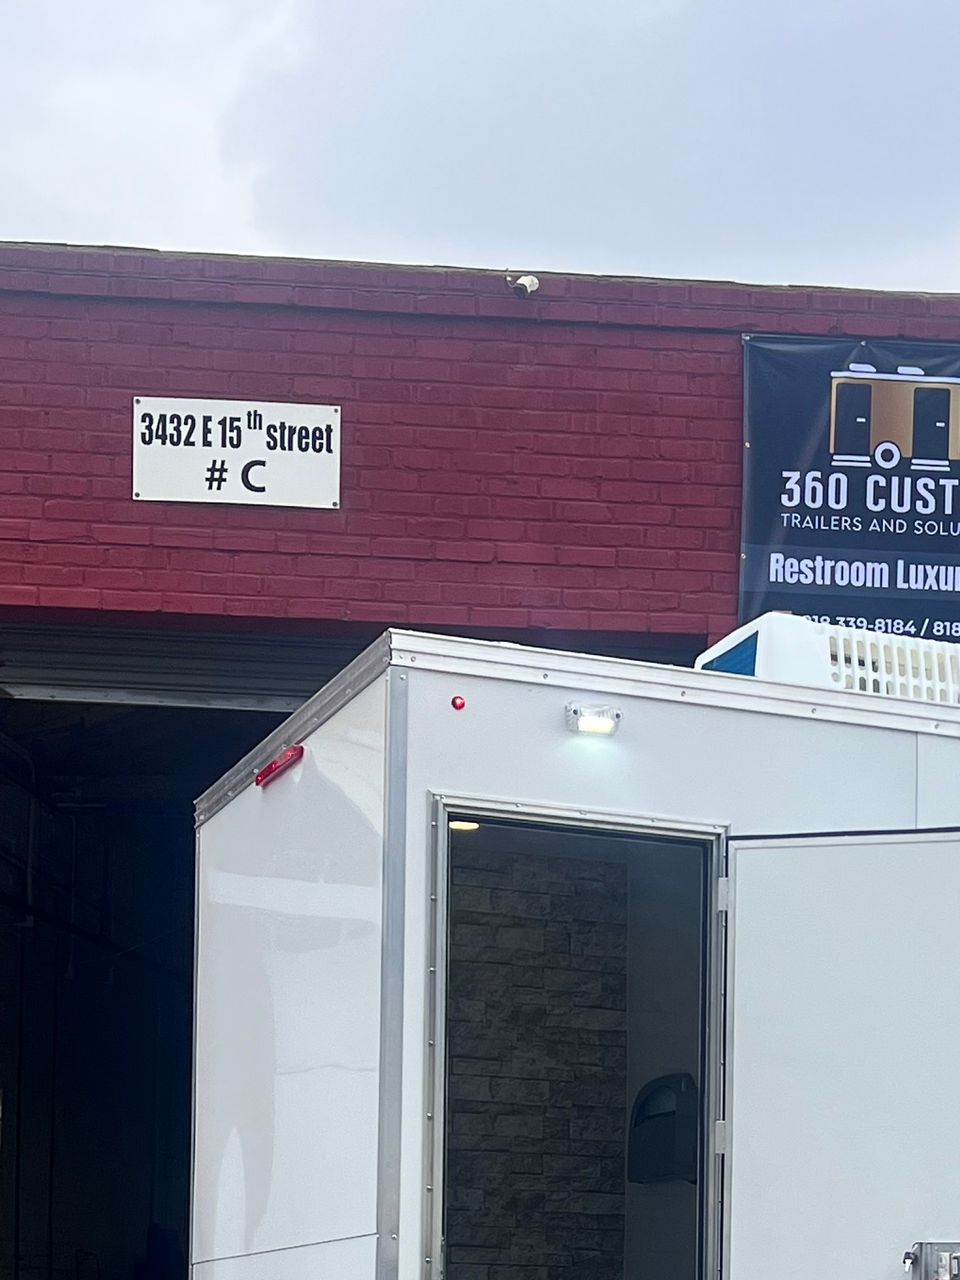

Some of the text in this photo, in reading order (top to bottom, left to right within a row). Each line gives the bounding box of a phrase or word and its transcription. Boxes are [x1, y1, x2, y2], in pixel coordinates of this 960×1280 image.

[141, 412, 196, 446] 3432
[202, 415, 212, 447] E
[205, 459, 266, 492] # C
[780, 470, 848, 510] 360
[781, 512, 862, 532] TRAILERS
[869, 517, 907, 535] AND
[769, 552, 889, 588] Restroom
